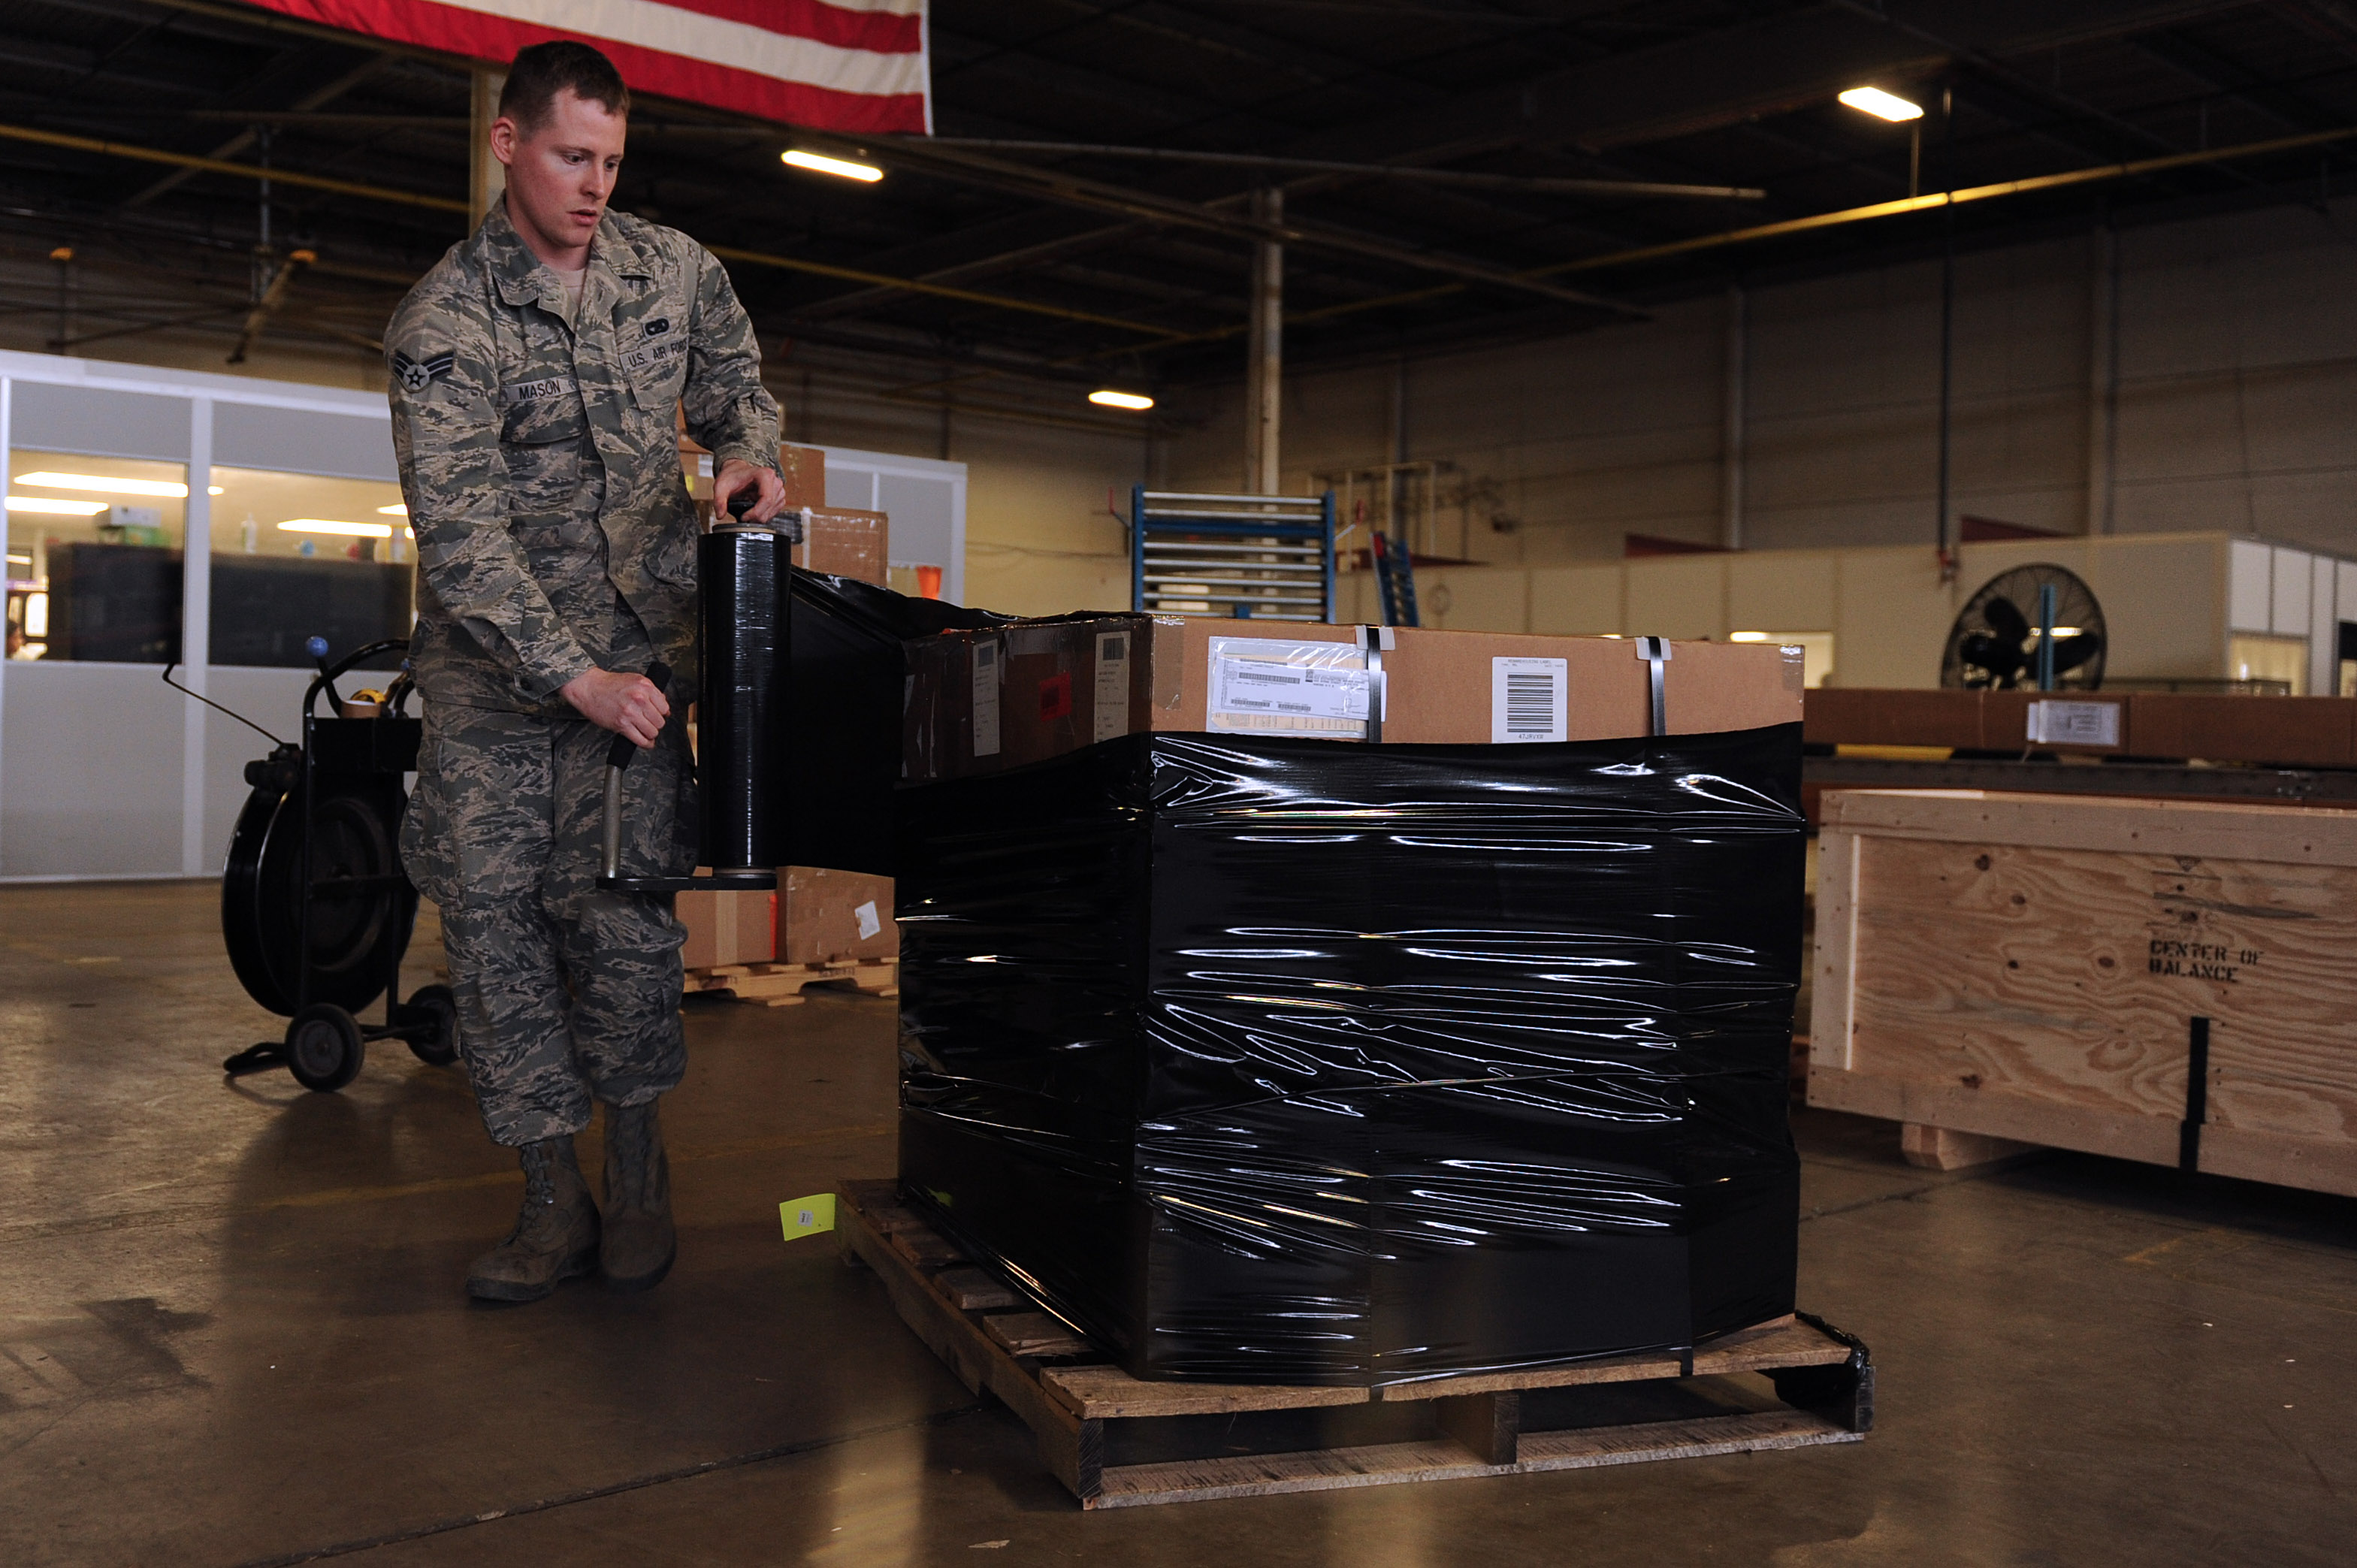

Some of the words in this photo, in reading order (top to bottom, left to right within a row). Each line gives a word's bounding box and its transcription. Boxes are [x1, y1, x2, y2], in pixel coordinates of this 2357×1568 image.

[628, 352, 648, 367] U.S.
[652, 346, 667, 361] AIR
[519, 380, 561, 400] MASON
[2150, 940, 2226, 961] CENTER
[2241, 950, 2264, 965] OF
[2150, 958, 2238, 983] BALANCE
